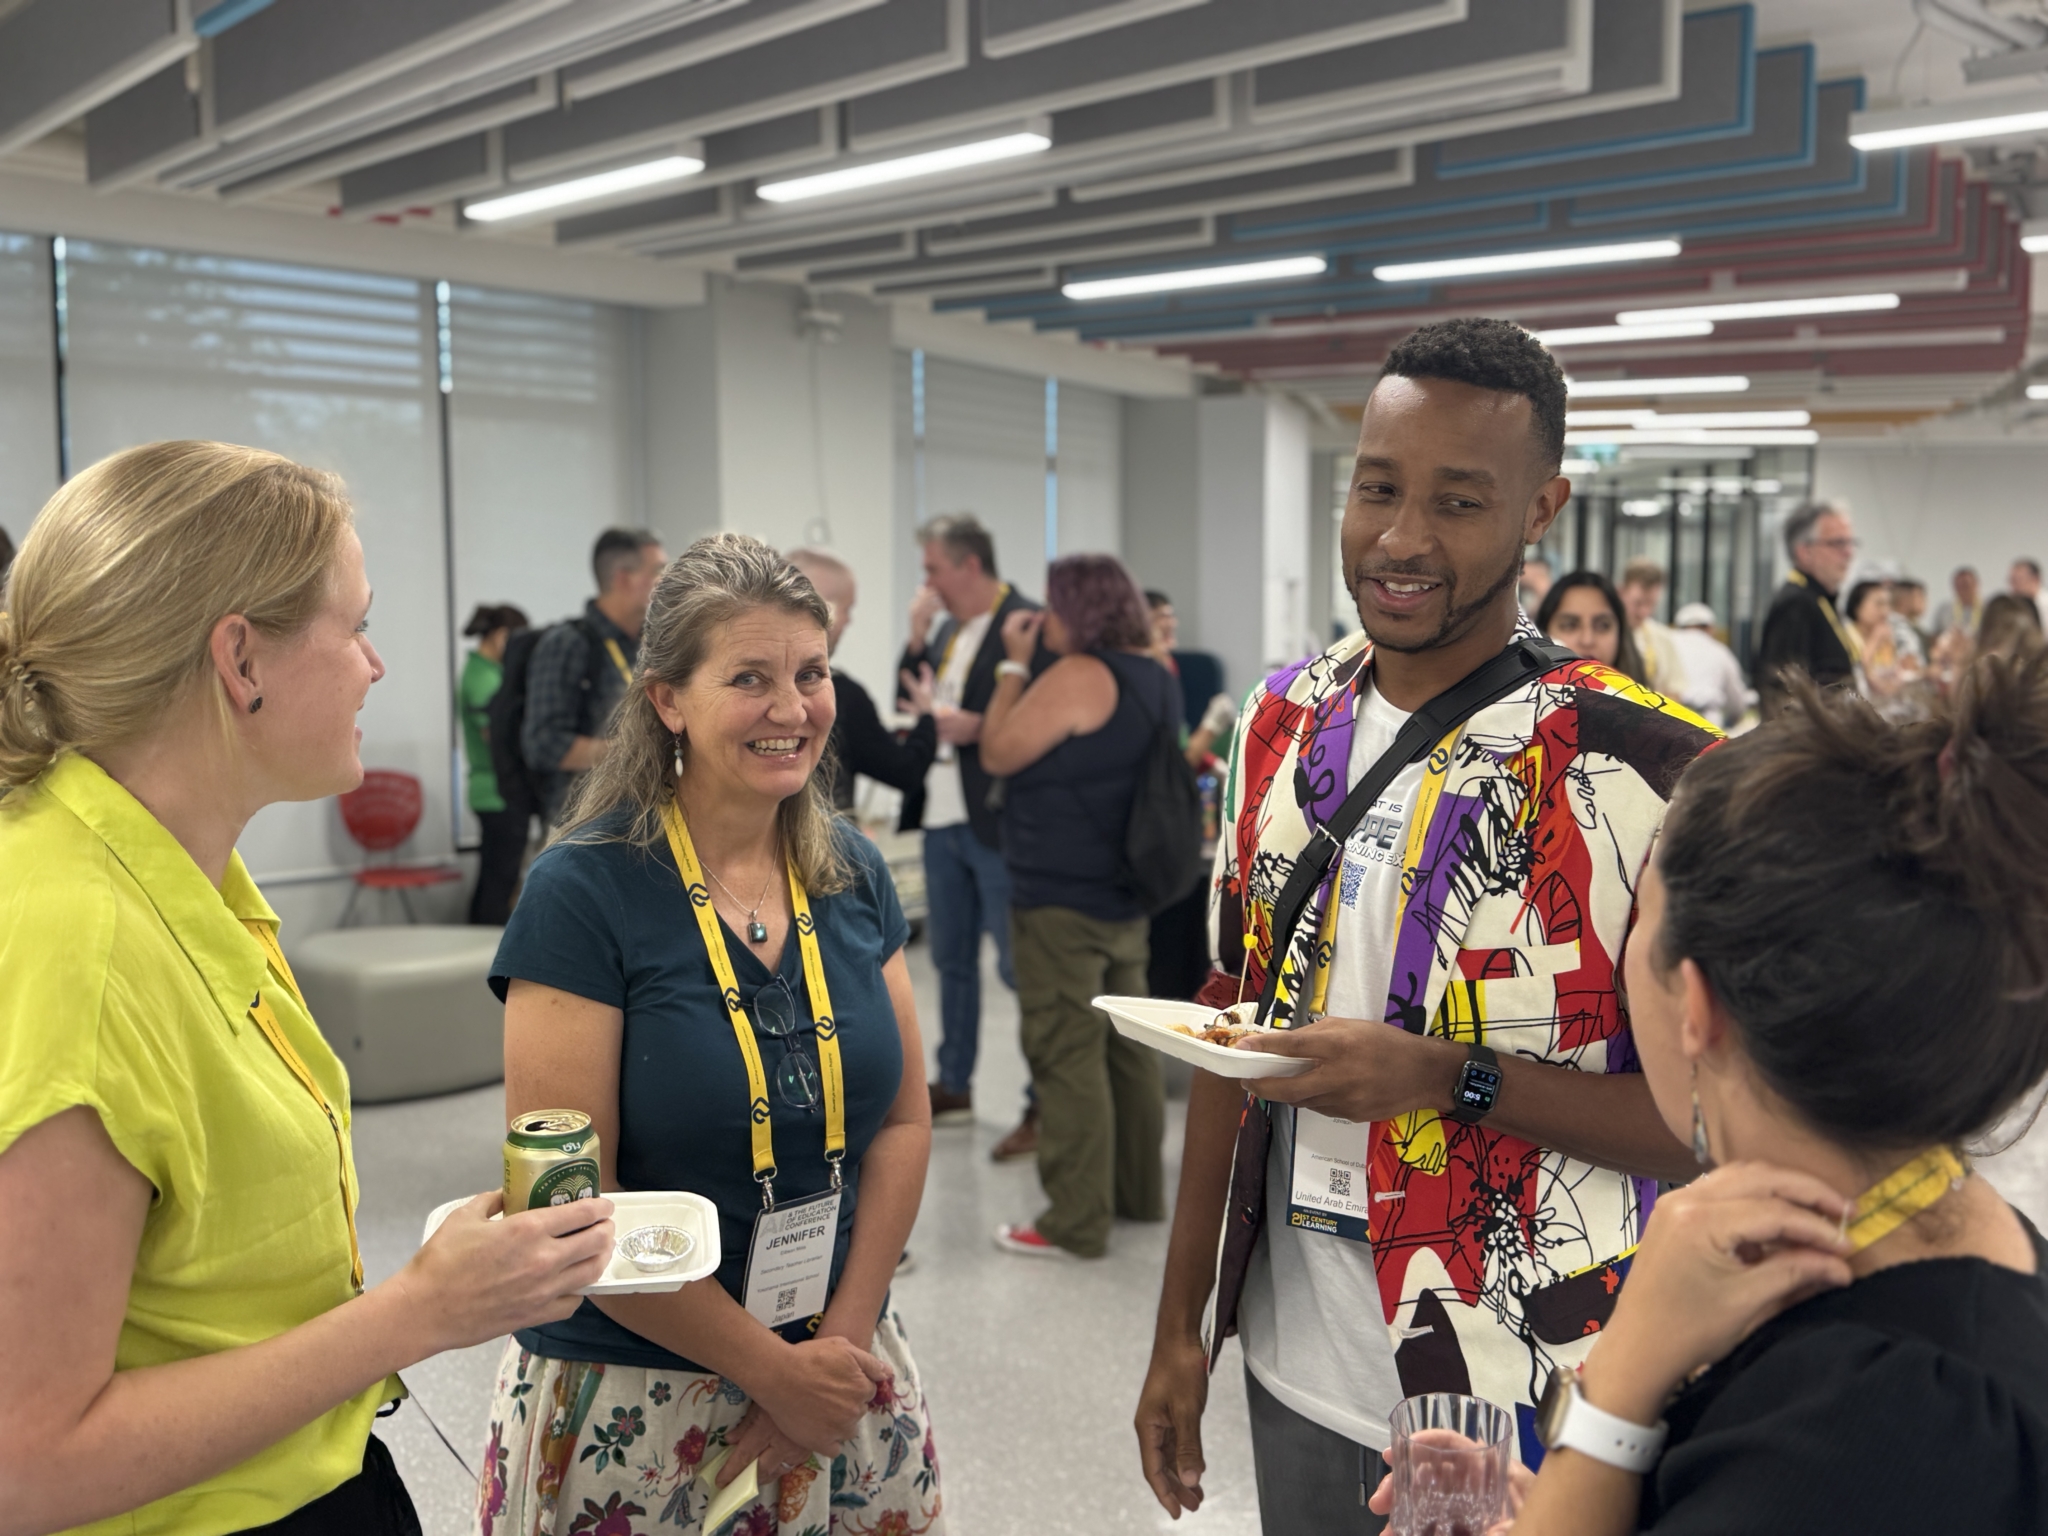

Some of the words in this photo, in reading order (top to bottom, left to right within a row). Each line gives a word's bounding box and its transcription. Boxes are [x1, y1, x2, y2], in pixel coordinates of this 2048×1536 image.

[1388, 803, 1403, 813] IS
[1346, 841, 1385, 862] RNING
[1385, 851, 1406, 869] EX
[1463, 1090, 1481, 1101] 5:00
[1311, 1153, 1333, 1162] American
[1333, 1157, 1350, 1166] School
[794, 1207, 808, 1216] THE
[808, 1198, 835, 1212] FUTURE
[1295, 1190, 1323, 1204] United
[1323, 1196, 1344, 1209] Arab
[1345, 1200, 1368, 1214] Emira
[784, 1212, 831, 1231] CONFERENCE
[786, 1215, 797, 1224] OF
[797, 1205, 837, 1221] EDUCATION
[1310, 1215, 1338, 1227] CENTURY
[1301, 1219, 1338, 1234] LEARNING
[765, 1225, 826, 1251] JENNIFER
[771, 1310, 795, 1324] Japan
